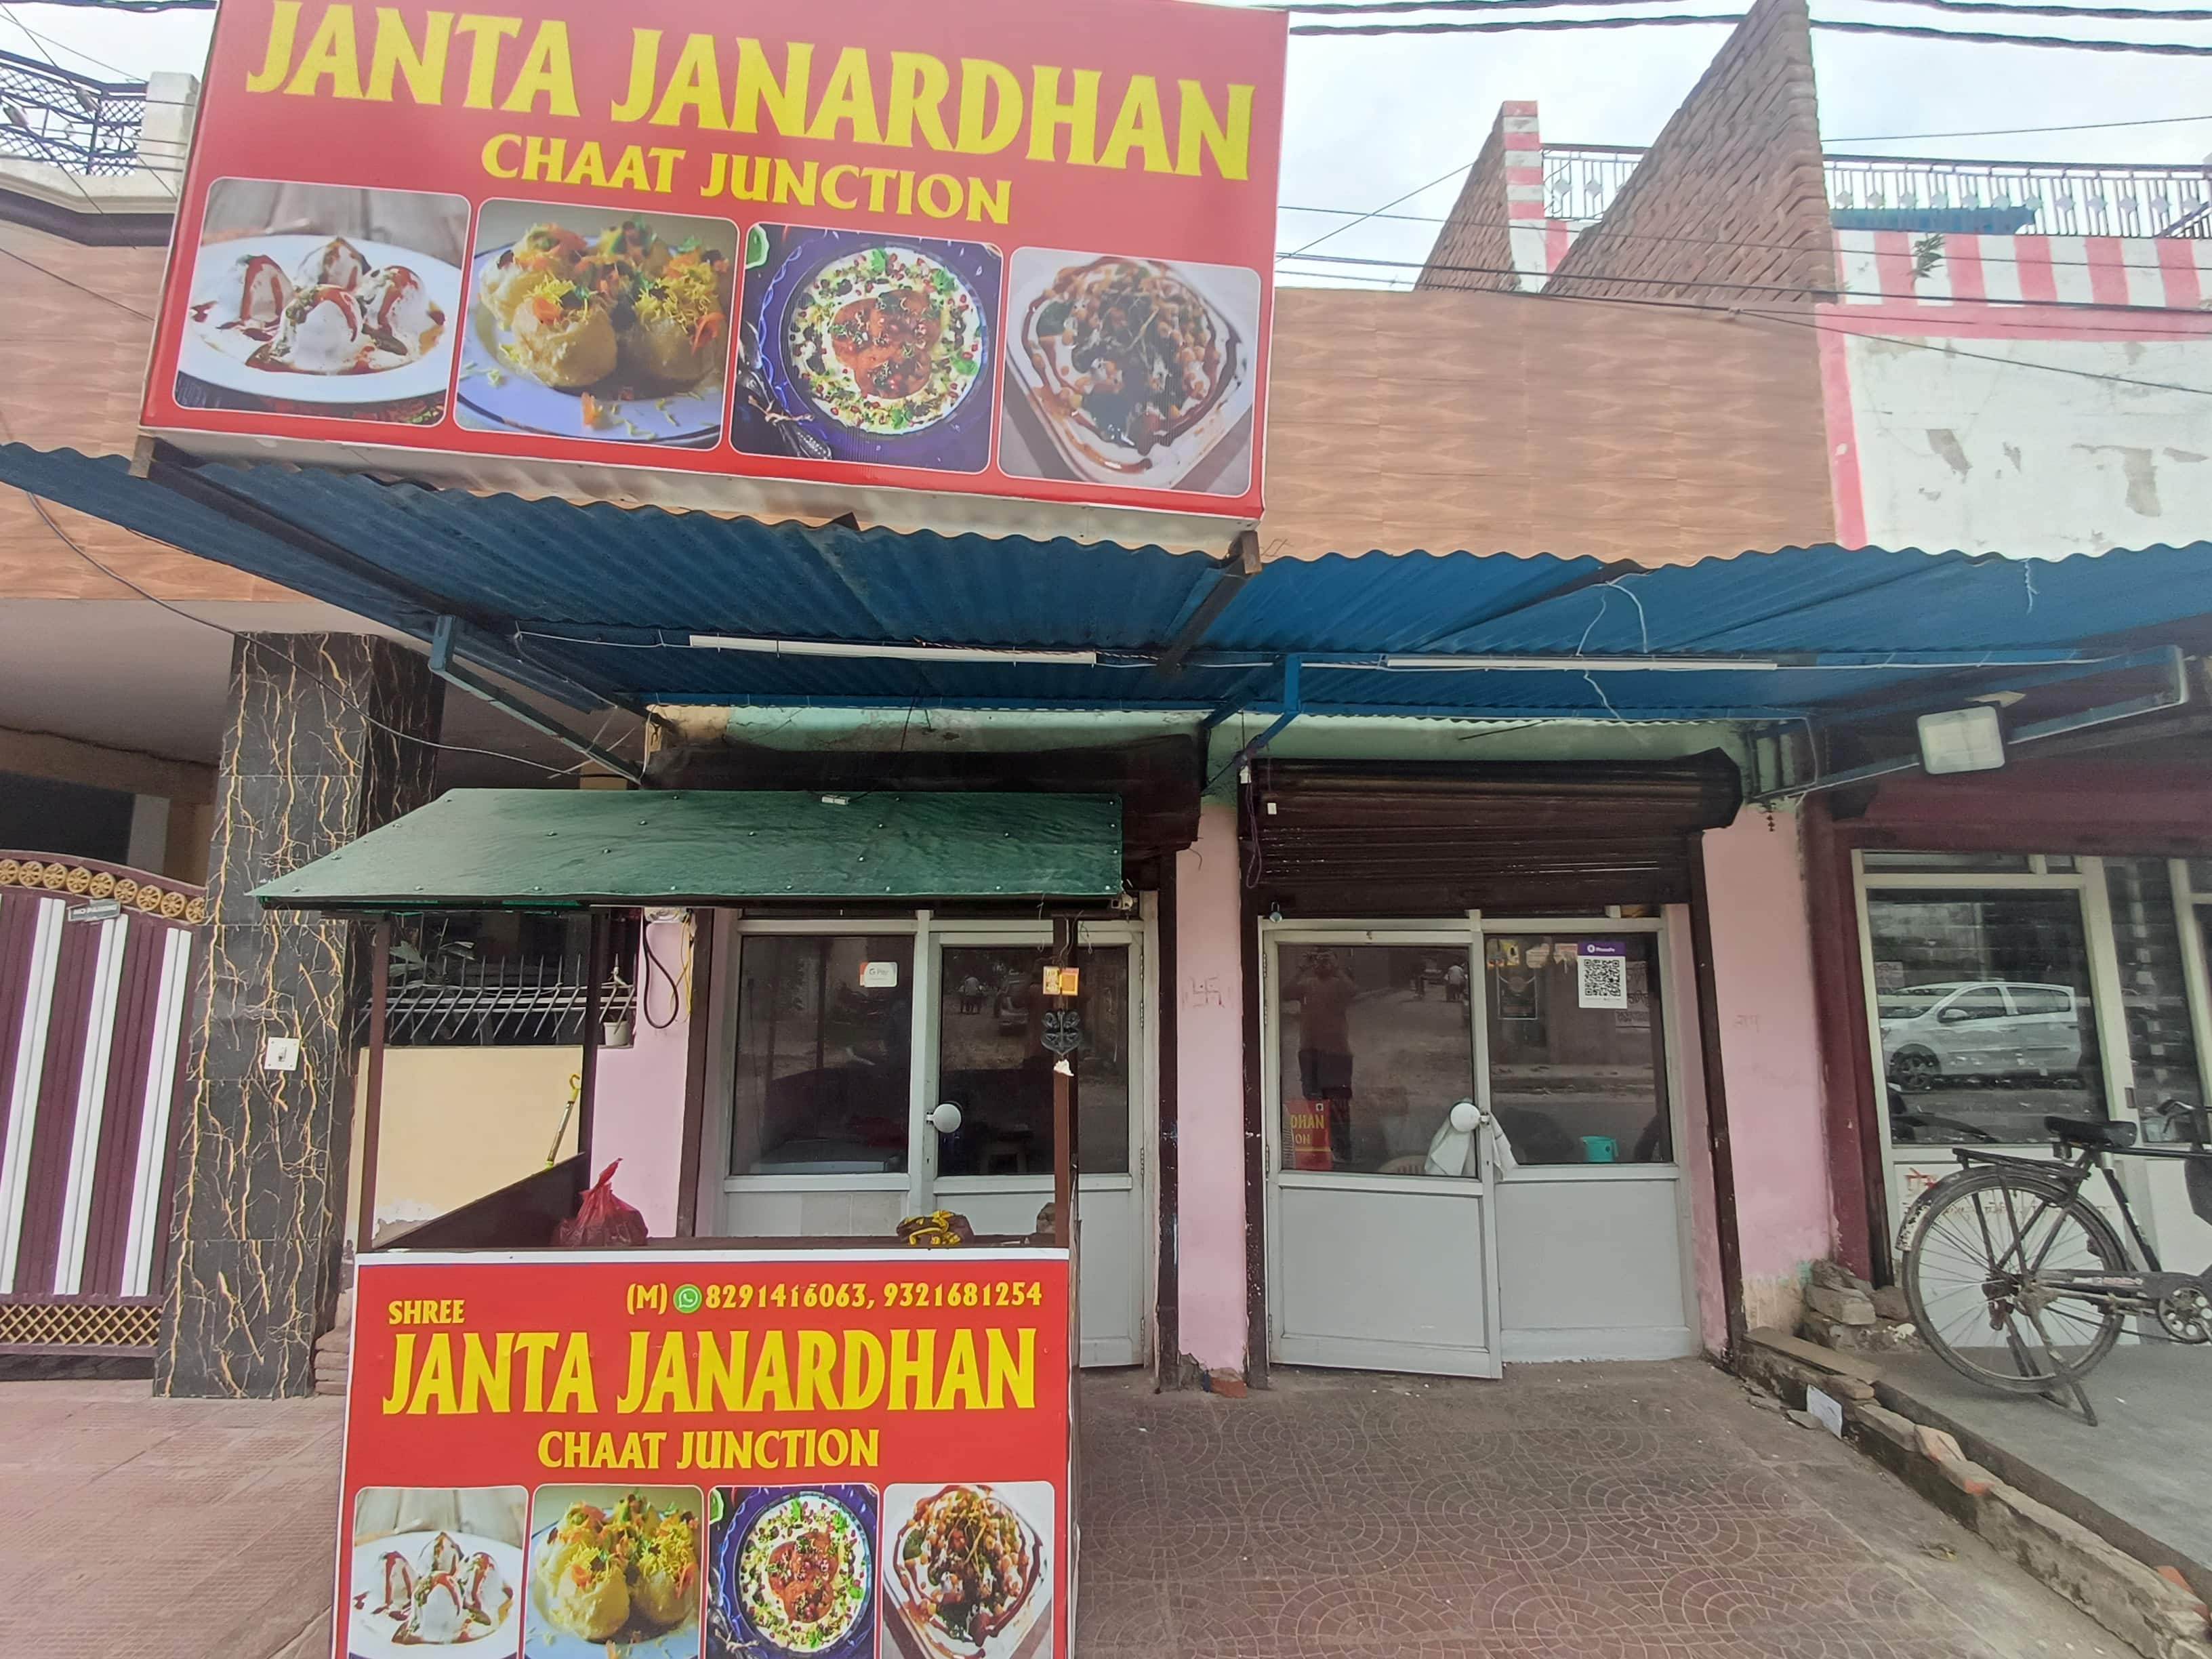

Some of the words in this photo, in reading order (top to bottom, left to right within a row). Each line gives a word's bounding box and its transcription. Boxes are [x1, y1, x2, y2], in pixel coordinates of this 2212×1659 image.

[246, 1, 580, 117] JANTA
[611, 30, 1256, 181] JANARDHAN
[481, 134, 686, 194] CHAAT
[701, 153, 1013, 225] JUNCTION
[388, 1300, 465, 1325] SHREE
[626, 1284, 668, 1315] (M)
[705, 1283, 875, 1310] 8291416063,
[884, 1282, 1042, 1308] 9321681254
[383, 1332, 599, 1415] JANTA
[617, 1328, 1037, 1414] JANARDHAN
[537, 1431, 668, 1469] CHAAT
[677, 1429, 880, 1469] JUNCTION
